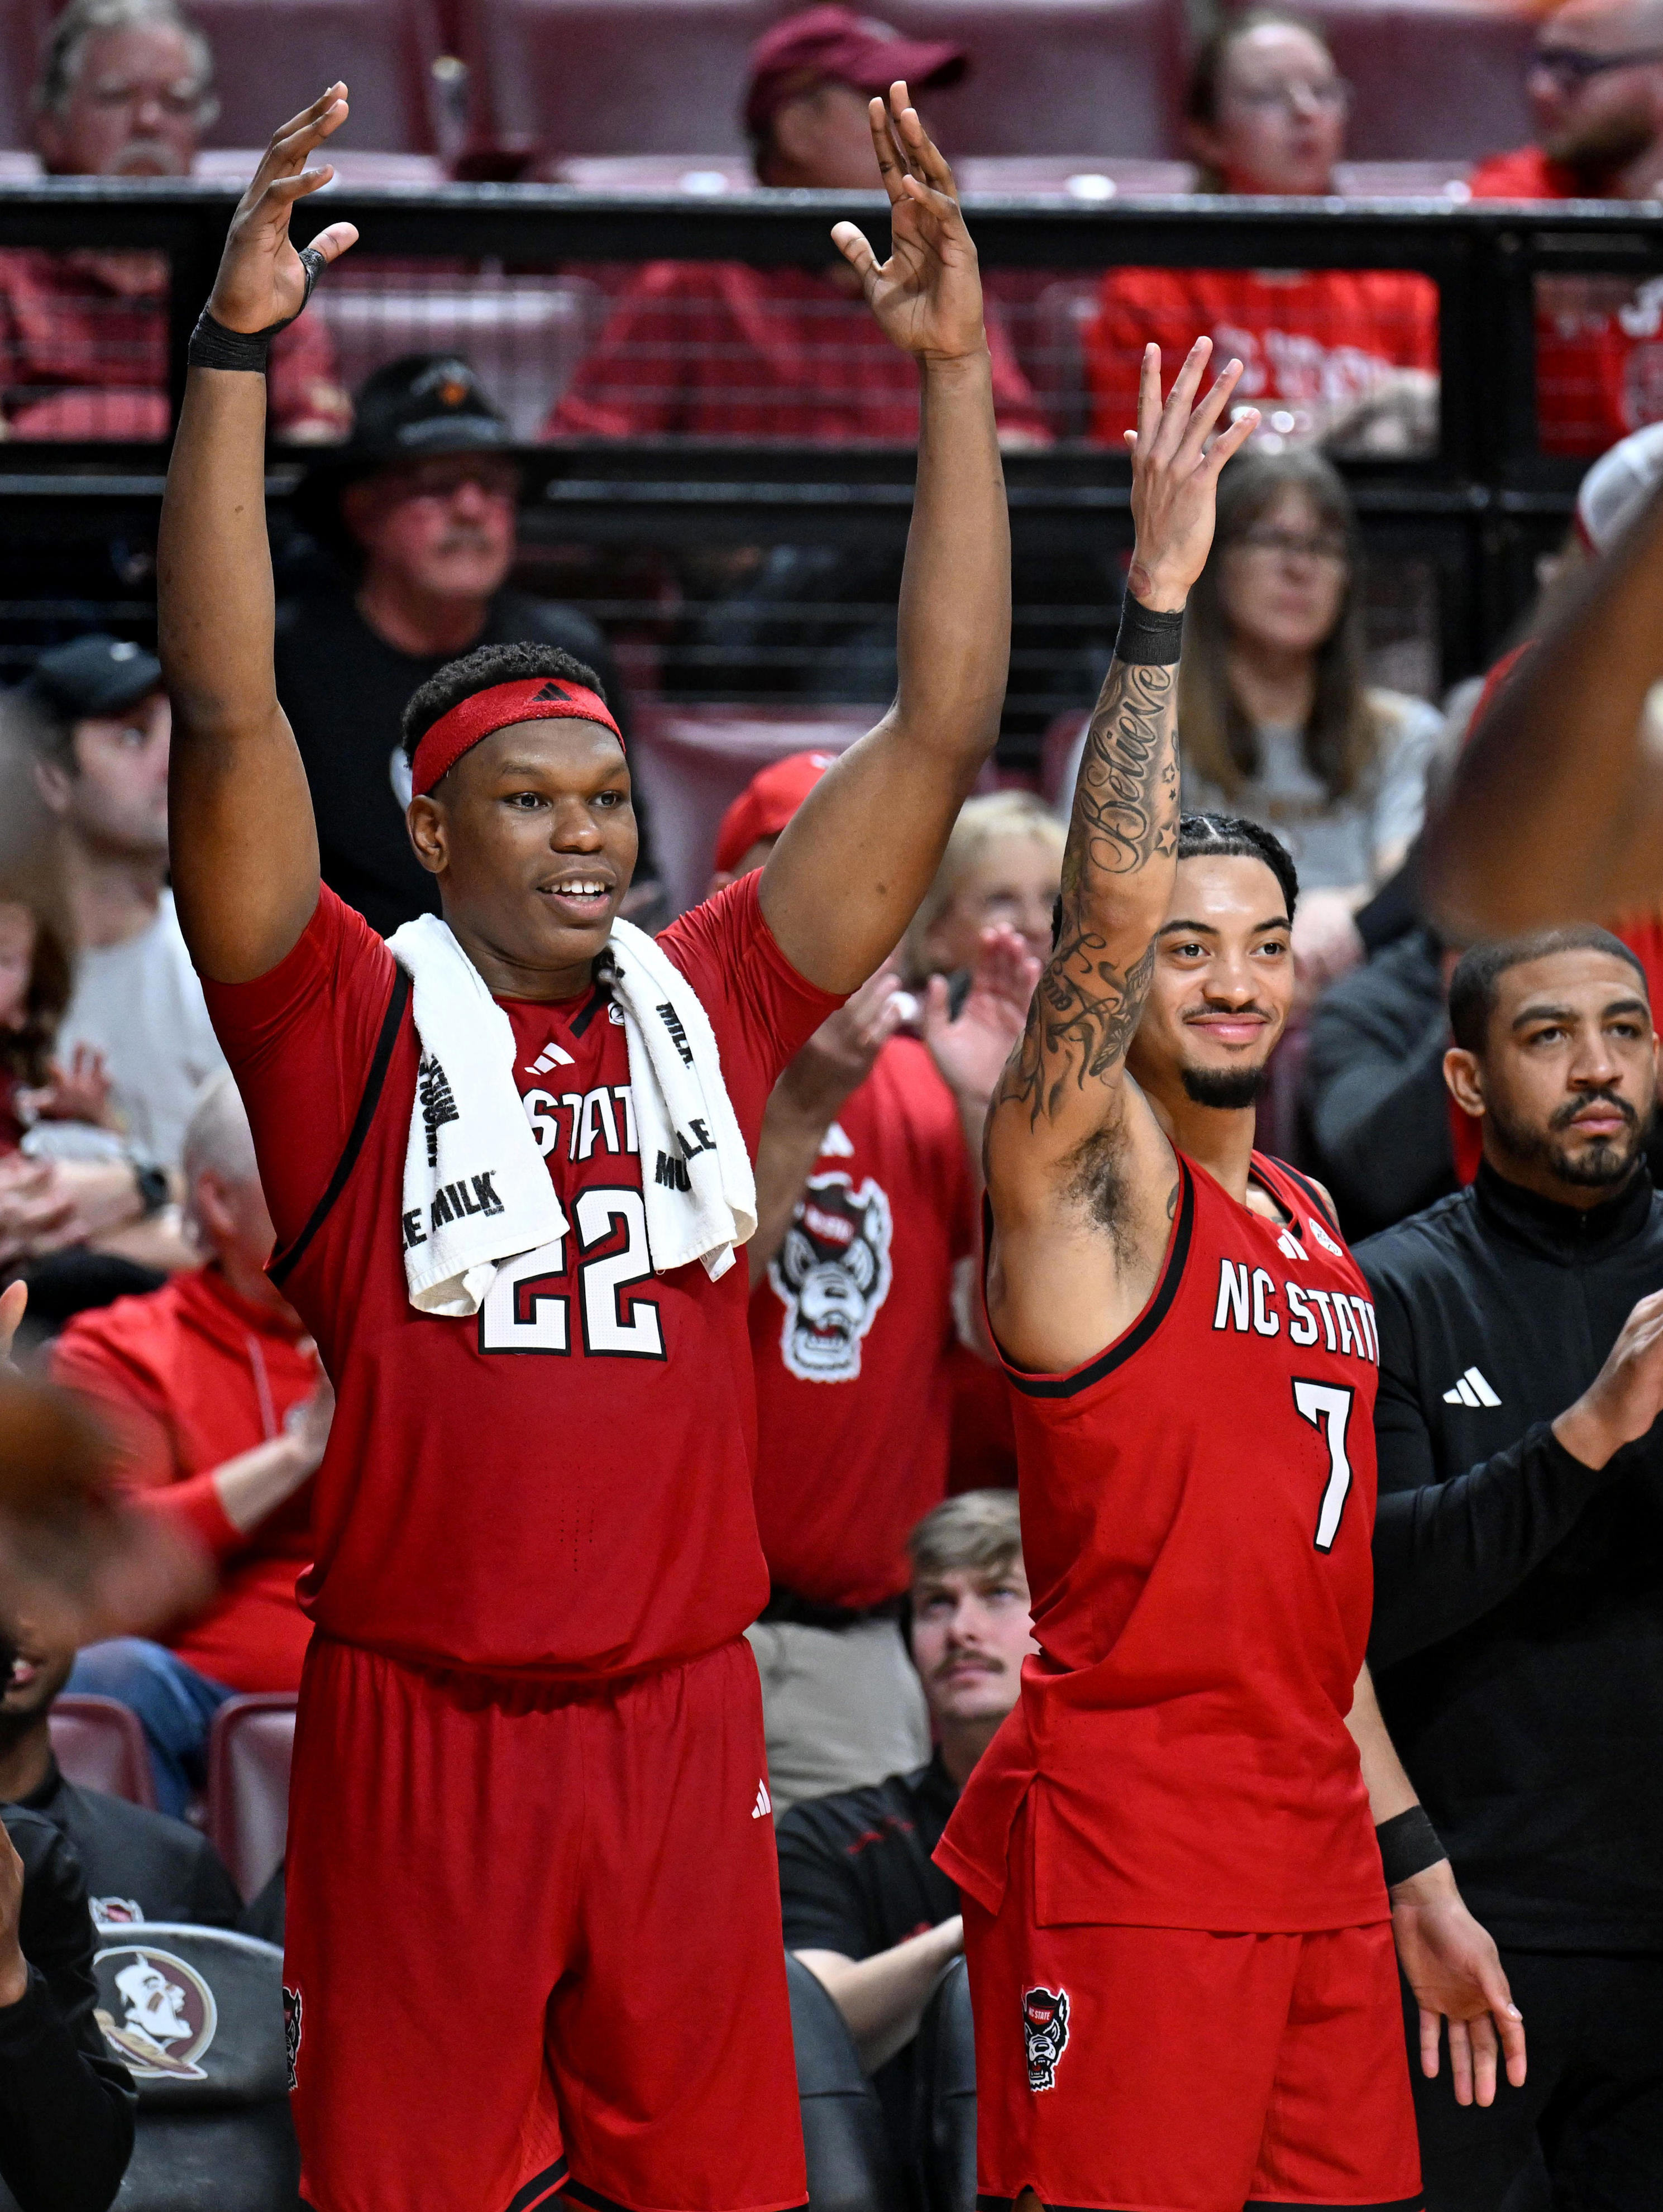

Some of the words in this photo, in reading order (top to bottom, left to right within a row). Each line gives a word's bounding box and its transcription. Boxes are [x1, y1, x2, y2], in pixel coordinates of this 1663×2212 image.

[522, 1084, 641, 1163] STAT
[431, 1171, 503, 1234] MILK
[478, 1184, 667, 1361] 22
[1212, 1258, 1280, 1337] NC
[1291, 1376, 1355, 1555] 7
[1035, 2010, 1051, 2020] STATE
